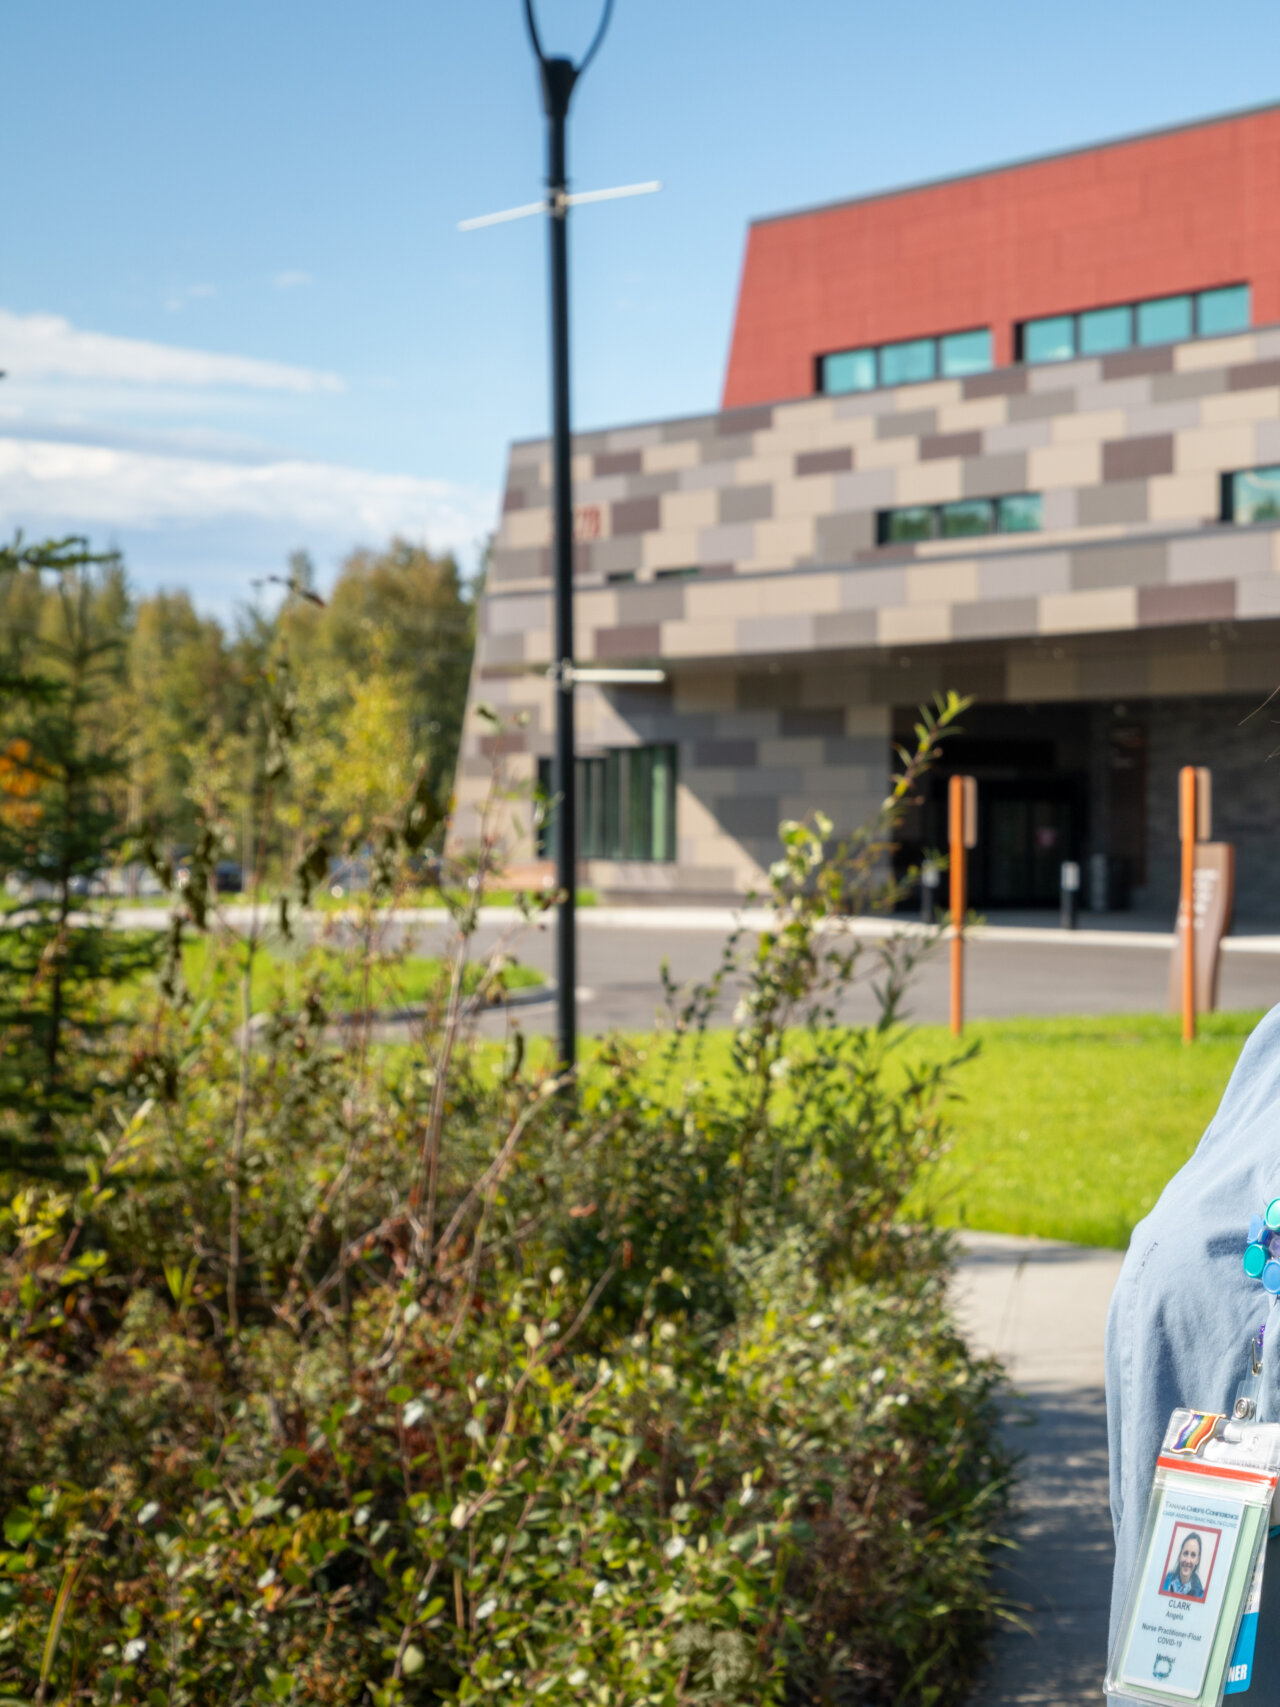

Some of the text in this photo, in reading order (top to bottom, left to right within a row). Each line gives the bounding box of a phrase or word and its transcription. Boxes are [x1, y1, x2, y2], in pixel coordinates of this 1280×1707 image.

[1168, 1599, 1191, 1611] CLARK
[1165, 1610, 1184, 1621] Angela
[1142, 1622, 1157, 1632] Nurse
[1157, 1636, 1182, 1648] COVID-19
